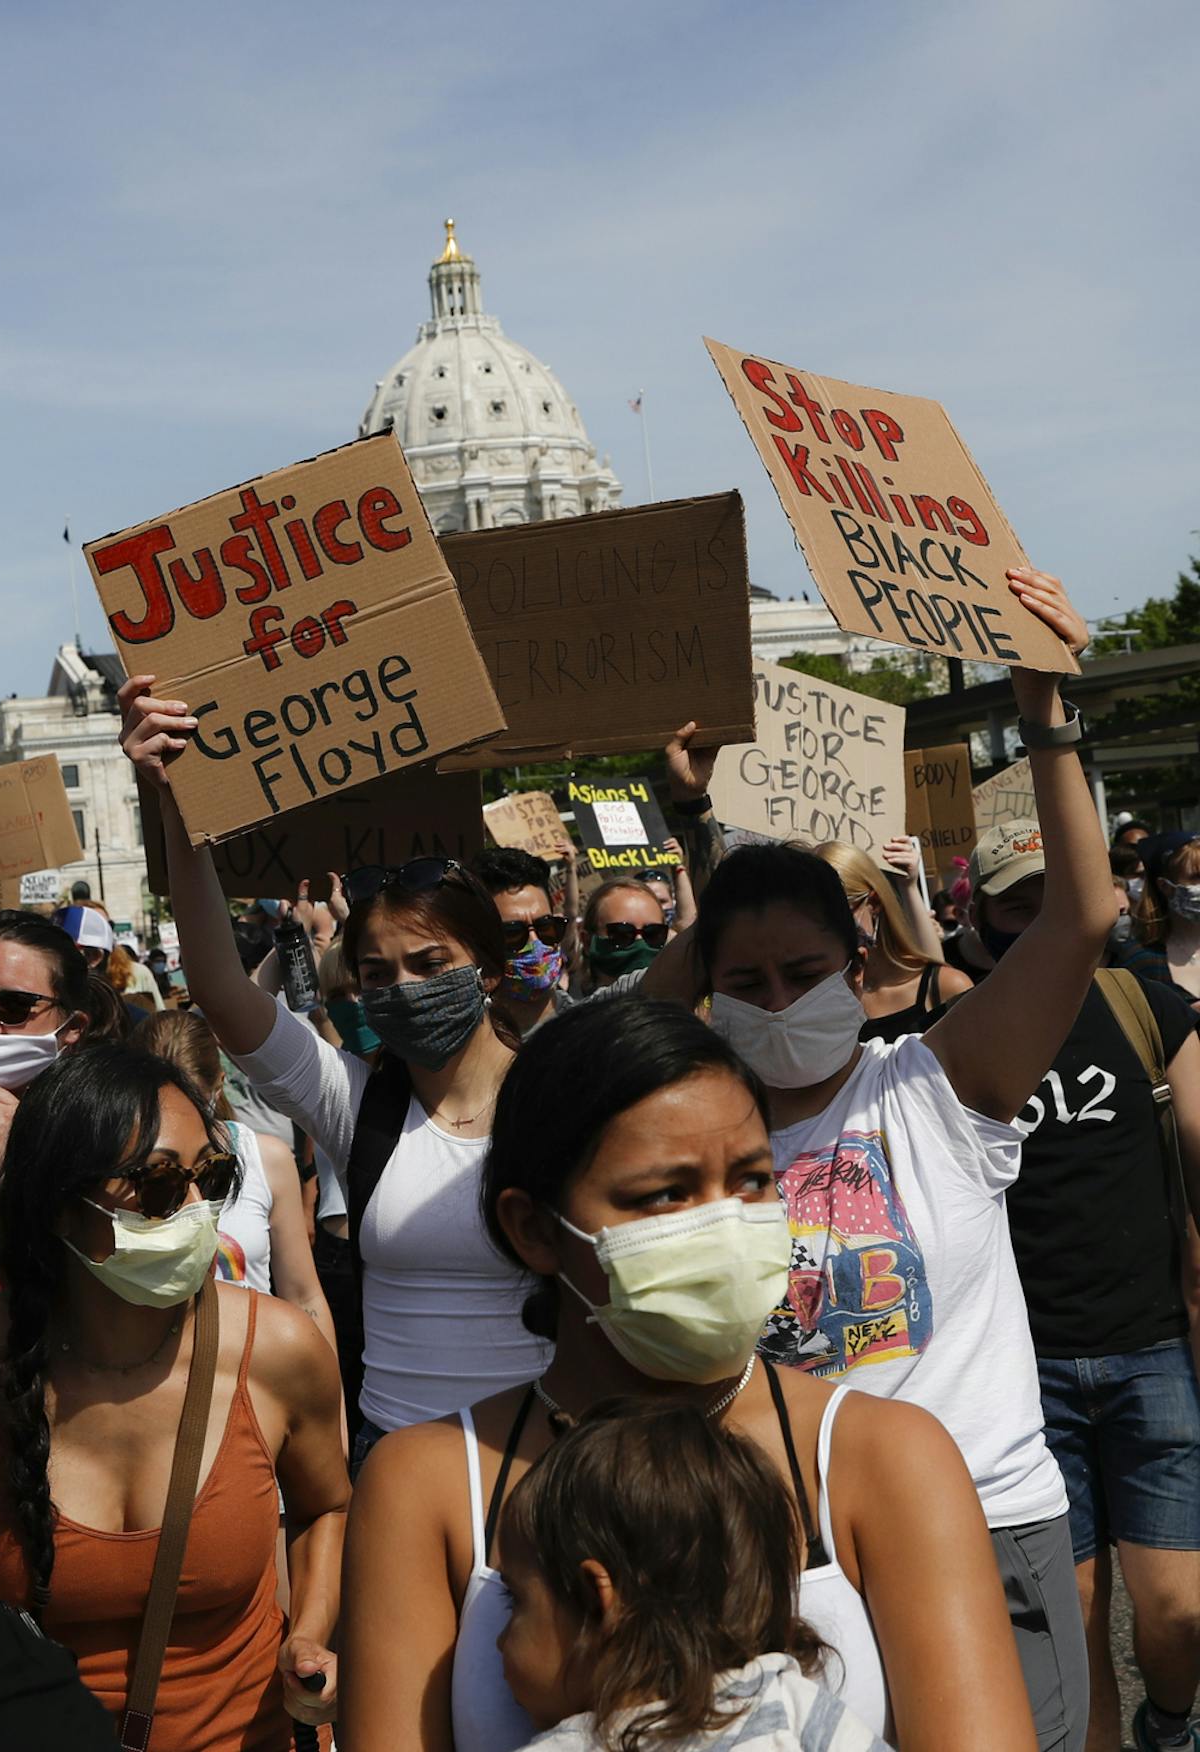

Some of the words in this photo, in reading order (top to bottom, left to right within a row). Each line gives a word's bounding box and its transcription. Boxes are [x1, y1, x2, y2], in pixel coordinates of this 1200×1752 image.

[741, 358, 905, 462] Stop
[771, 434, 990, 547] Killing
[90, 486, 413, 645] Justice
[454, 538, 678, 613] POLICING
[693, 535, 730, 596] IS
[243, 600, 359, 672] for
[479, 625, 710, 706] ERRORISM
[191, 654, 419, 760] George
[752, 672, 887, 746] JUSTICE
[251, 702, 429, 814] Floyd
[784, 721, 852, 777] FOR
[913, 759, 959, 799] BODY
[568, 782, 629, 804] Asians
[630, 783, 649, 803] 4
[739, 748, 887, 816] GEORGE
[972, 774, 1013, 806] MONG
[764, 796, 874, 852] FLOYD
[919, 827, 973, 849] SHIELD
[587, 847, 642, 869] Black
[905, 1266, 921, 1322] 2018
[847, 1316, 891, 1340] NEW
[847, 1323, 898, 1358] YORK
